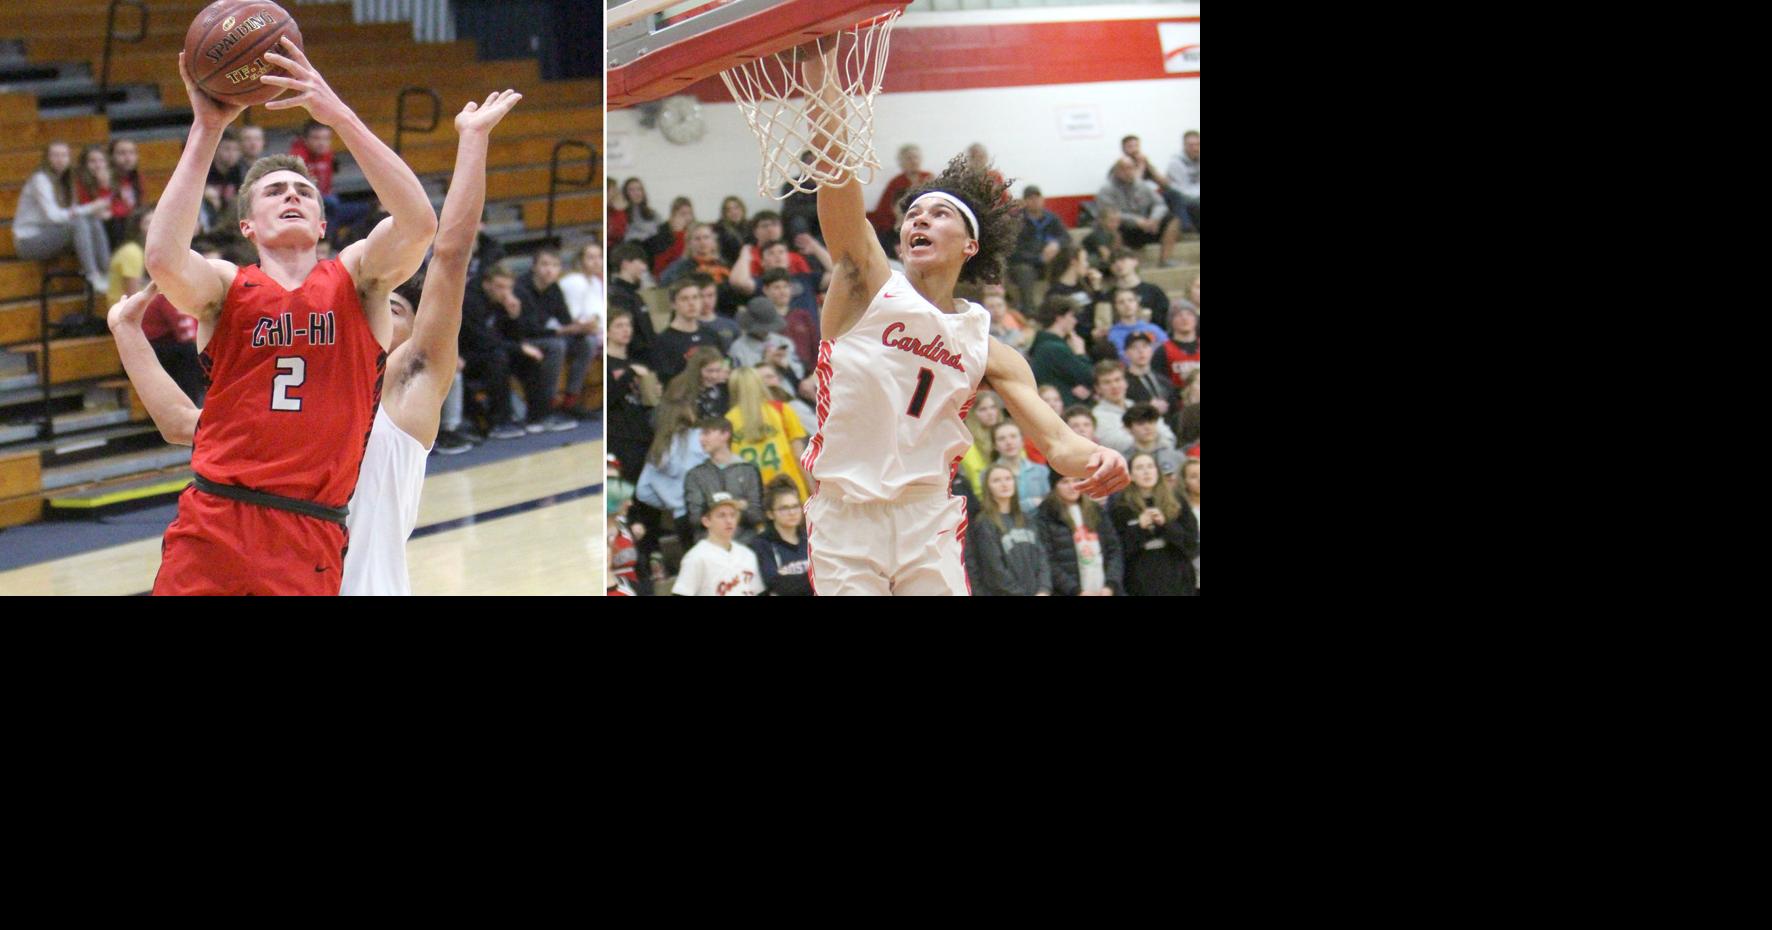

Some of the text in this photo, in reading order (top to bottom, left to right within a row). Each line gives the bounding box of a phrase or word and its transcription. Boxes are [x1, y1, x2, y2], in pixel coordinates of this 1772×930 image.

[206, 10, 277, 64] SPALDING
[252, 310, 336, 349] CHI-HI
[882, 321, 966, 373] Cardina
[270, 355, 307, 412] 2
[906, 366, 935, 419] 1
